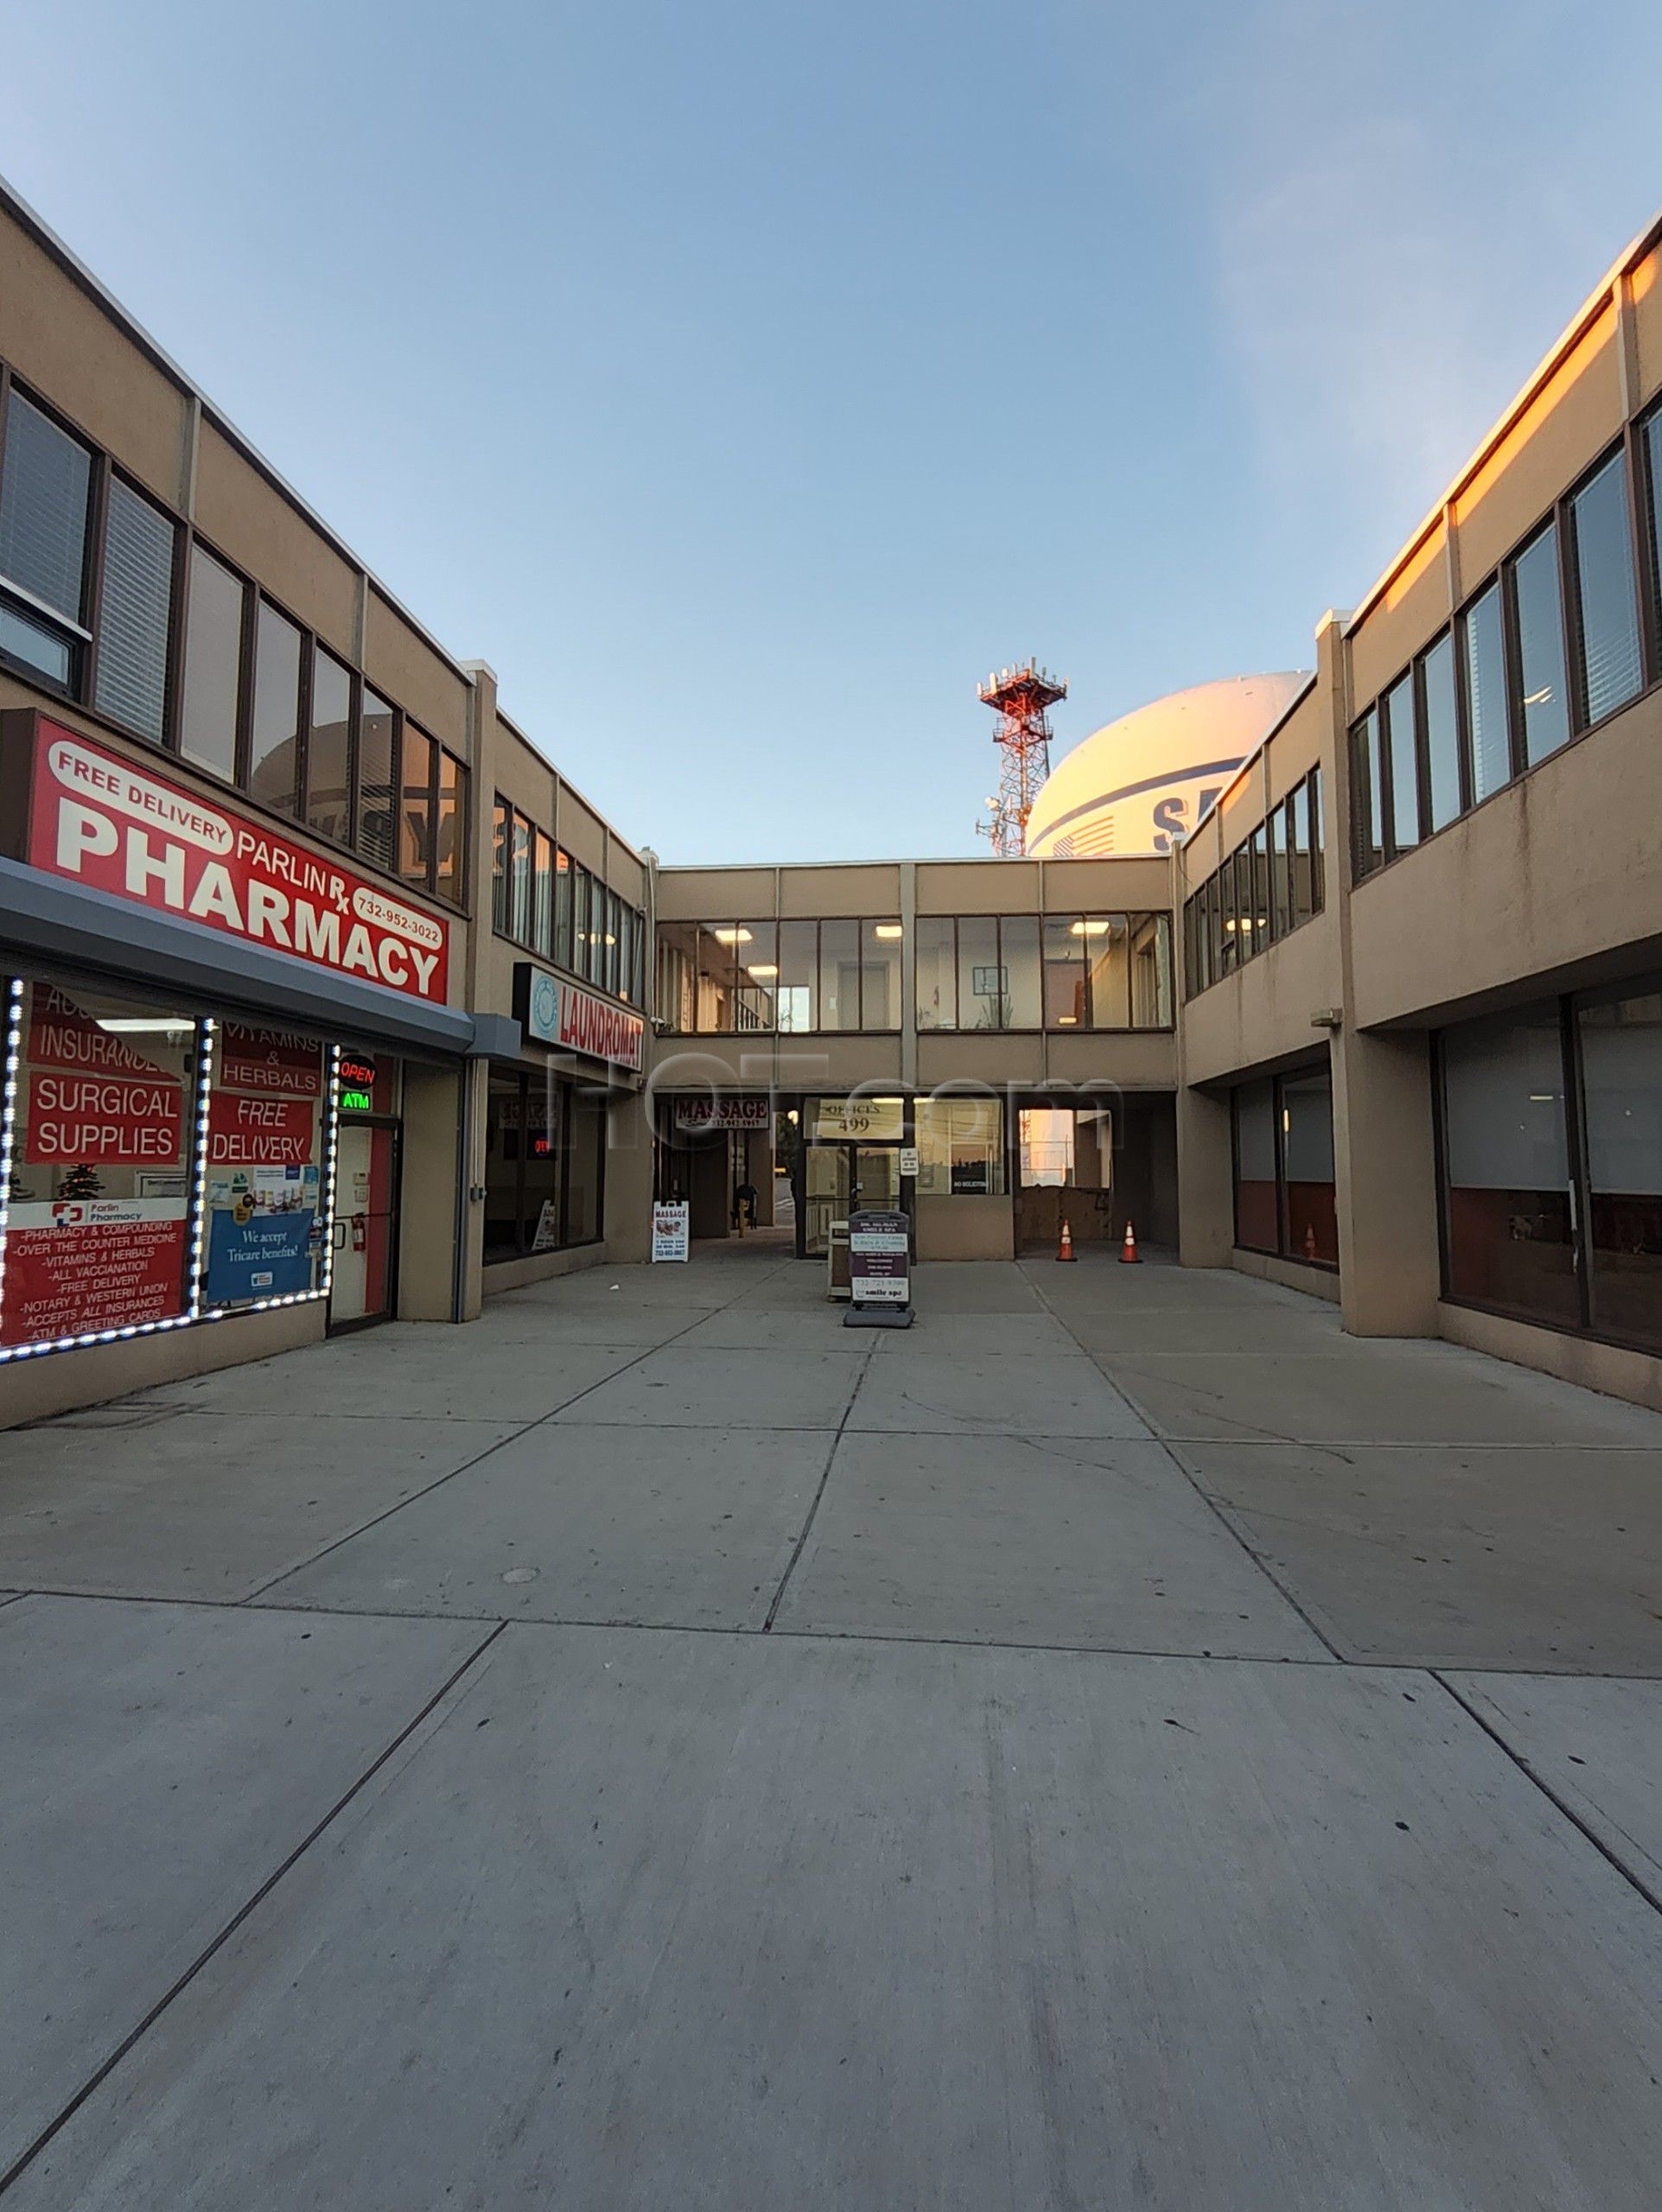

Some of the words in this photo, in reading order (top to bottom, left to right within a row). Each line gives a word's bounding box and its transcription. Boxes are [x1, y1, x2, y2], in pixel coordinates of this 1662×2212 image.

[58, 750, 121, 796] FREE
[128, 785, 227, 843] DELIVERY
[237, 830, 326, 896] PARLIN
[56, 796, 439, 995] PHARMACY
[358, 897, 439, 943] 732-952-3022
[560, 986, 641, 1069] LAUNDROMAT
[266, 1051, 280, 1066] &
[222, 1064, 316, 1090] HERBALS
[340, 1062, 376, 1084] OPEN
[37, 1078, 178, 1118] SURGICAL
[343, 1093, 369, 1109] ATM
[238, 1099, 289, 1127] FREE
[678, 1100, 767, 1120] MASSAGE
[838, 1117, 869, 1133] 499
[37, 1122, 173, 1155] SUPPLIES
[213, 1134, 304, 1160] DELIVERY
[91, 1204, 119, 1212] Parlin
[91, 1212, 143, 1221] Pharmacy
[655, 1210, 686, 1218] MASSAGE
[91, 1226, 99, 1236] &
[102, 1221, 173, 1236] COMPOUNDING
[243, 1230, 258, 1243] We
[259, 1231, 288, 1245] accept
[55, 1240, 79, 1252] THE
[81, 1236, 130, 1250] COUNTER
[134, 1232, 177, 1246] MEDICINE
[111, 1247, 155, 1260] HERBALS
[226, 1248, 260, 1262] Tricare
[92, 1274, 142, 1290] DELIVERY
[86, 1288, 136, 1304] WESTERN
[139, 1282, 169, 1295] UNION
[81, 1307, 101, 1319] ALL
[105, 1295, 165, 1314] INSURANCES
[71, 1315, 125, 1333] GREETING
